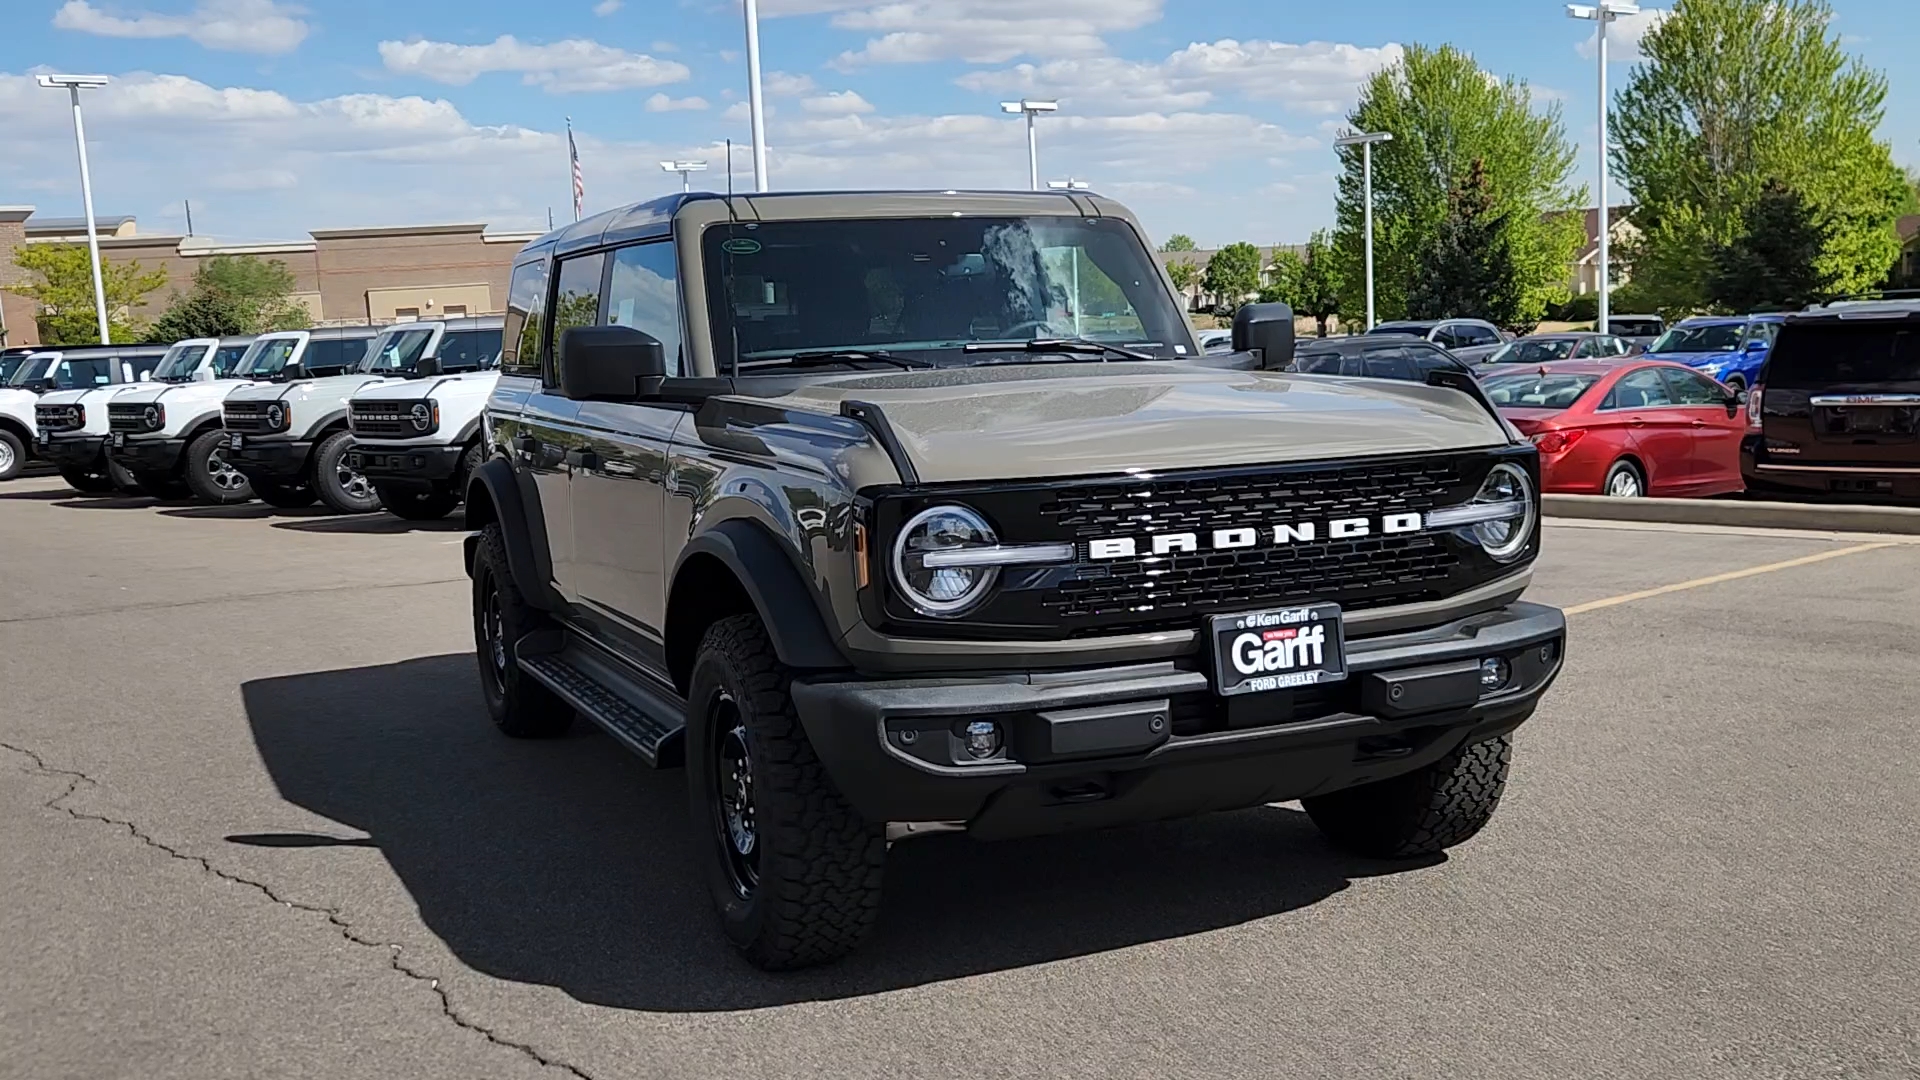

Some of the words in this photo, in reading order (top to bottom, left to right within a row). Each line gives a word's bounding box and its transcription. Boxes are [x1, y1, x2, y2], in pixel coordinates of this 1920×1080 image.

[1089, 511, 1421, 559] BRONCO
[1257, 613, 1280, 626] Ken
[1280, 609, 1309, 624] Garff
[1231, 625, 1324, 675] Garff
[1251, 678, 1277, 692] FORD
[1278, 672, 1319, 688] GREELEY
